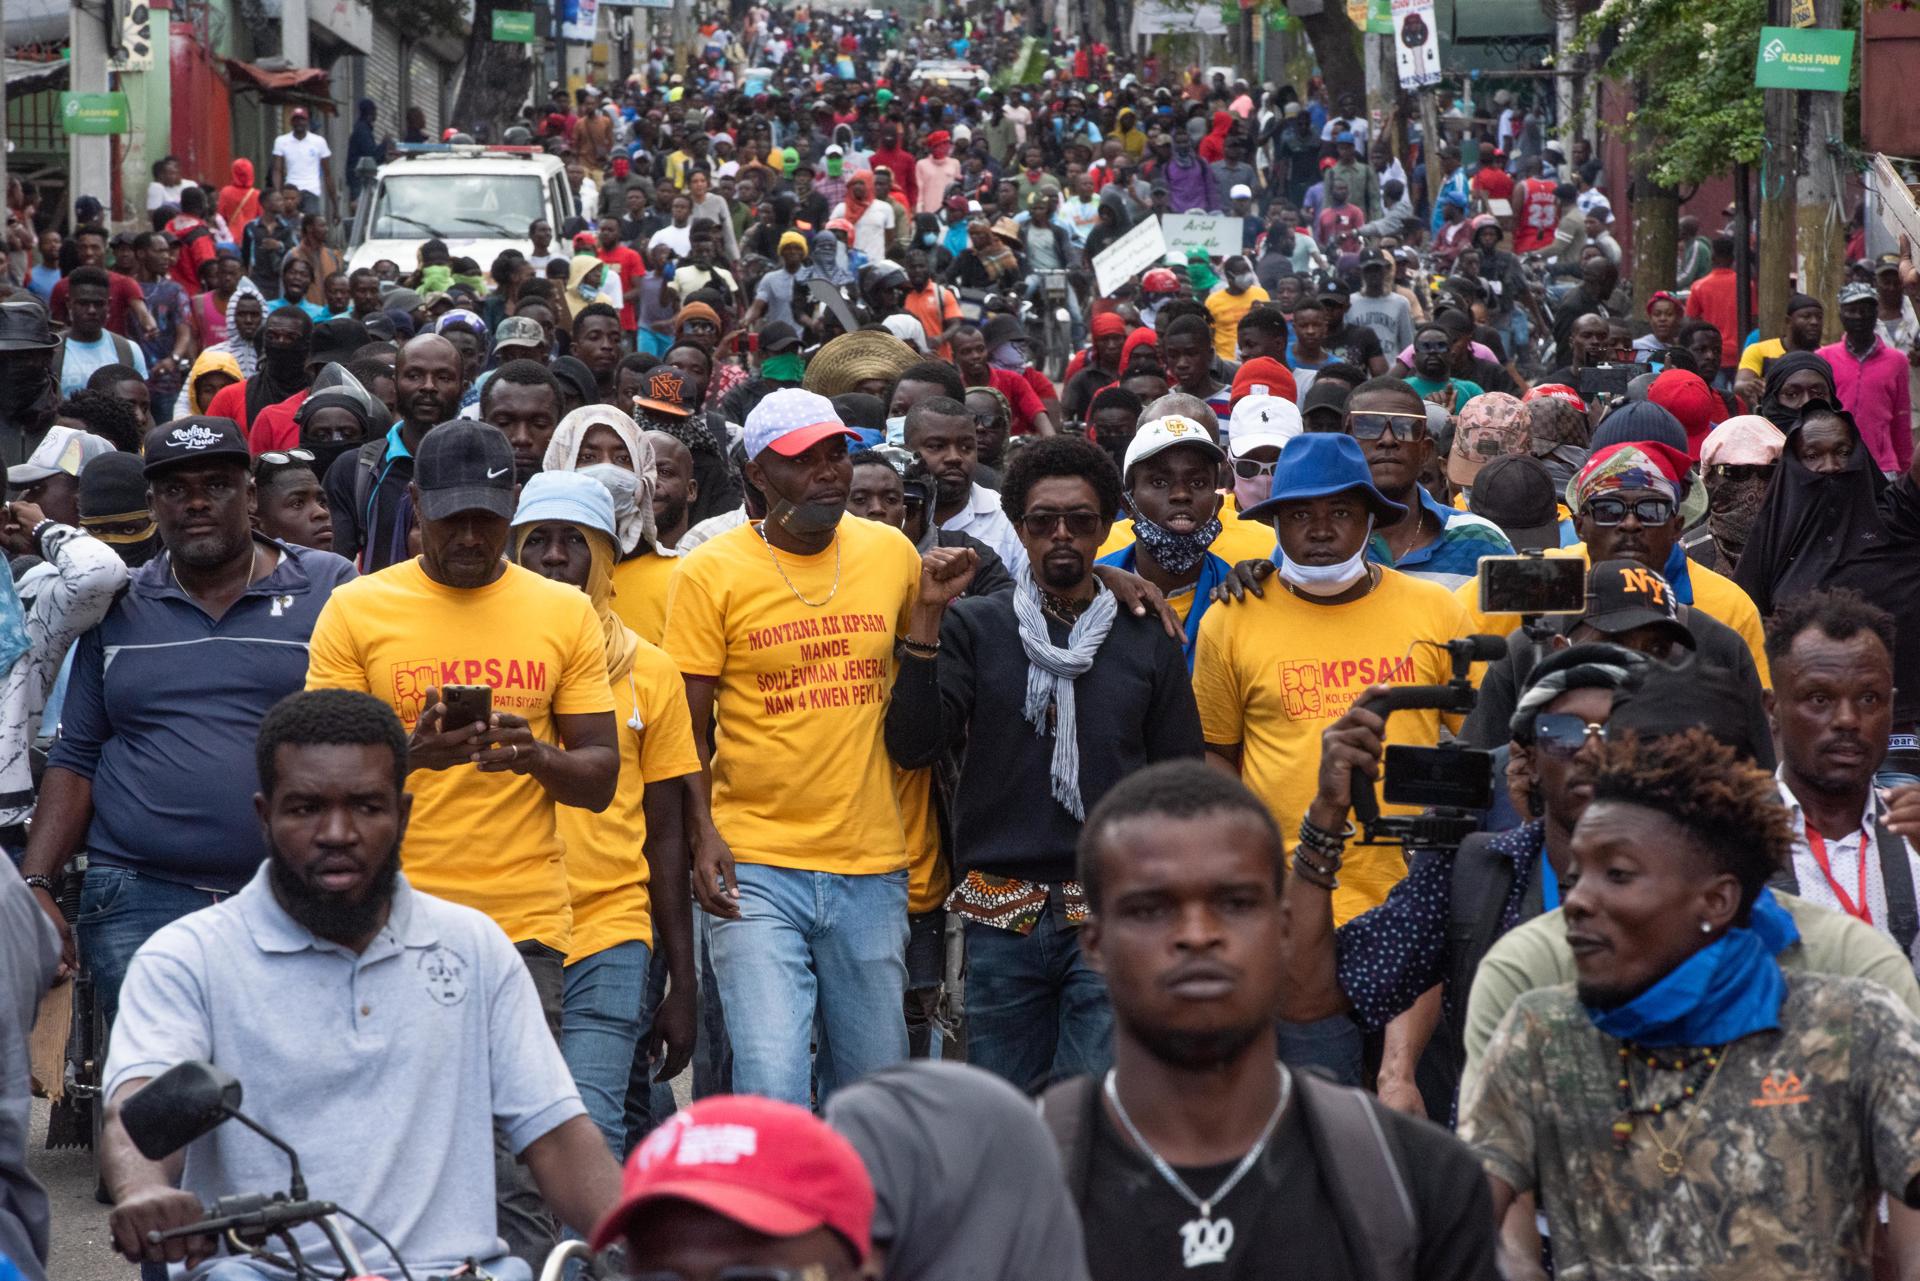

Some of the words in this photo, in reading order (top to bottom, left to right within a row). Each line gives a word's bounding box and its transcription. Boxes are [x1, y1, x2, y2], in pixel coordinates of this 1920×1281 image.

[1781, 52, 1813, 64] KASH
[1815, 54, 1841, 65] PAW
[1528, 204, 1555, 227] 23
[172, 424, 224, 441] Rolling
[1618, 567, 1665, 606] NY
[747, 618, 820, 651] MONTANA
[821, 615, 841, 636] AK
[841, 614, 887, 633] KPSAM
[800, 638, 850, 662] MANDE
[440, 658, 546, 692] KPSAM
[756, 663, 839, 693] SOULÈVMAN
[842, 658, 887, 681] JENERAL
[1321, 656, 1416, 688] KPSAM
[493, 695, 515, 707] PATI
[764, 694, 795, 716] NAN
[798, 690, 807, 711] 4
[809, 686, 850, 709] KWEN
[851, 683, 875, 705] PEYI
[877, 683, 883, 704] A
